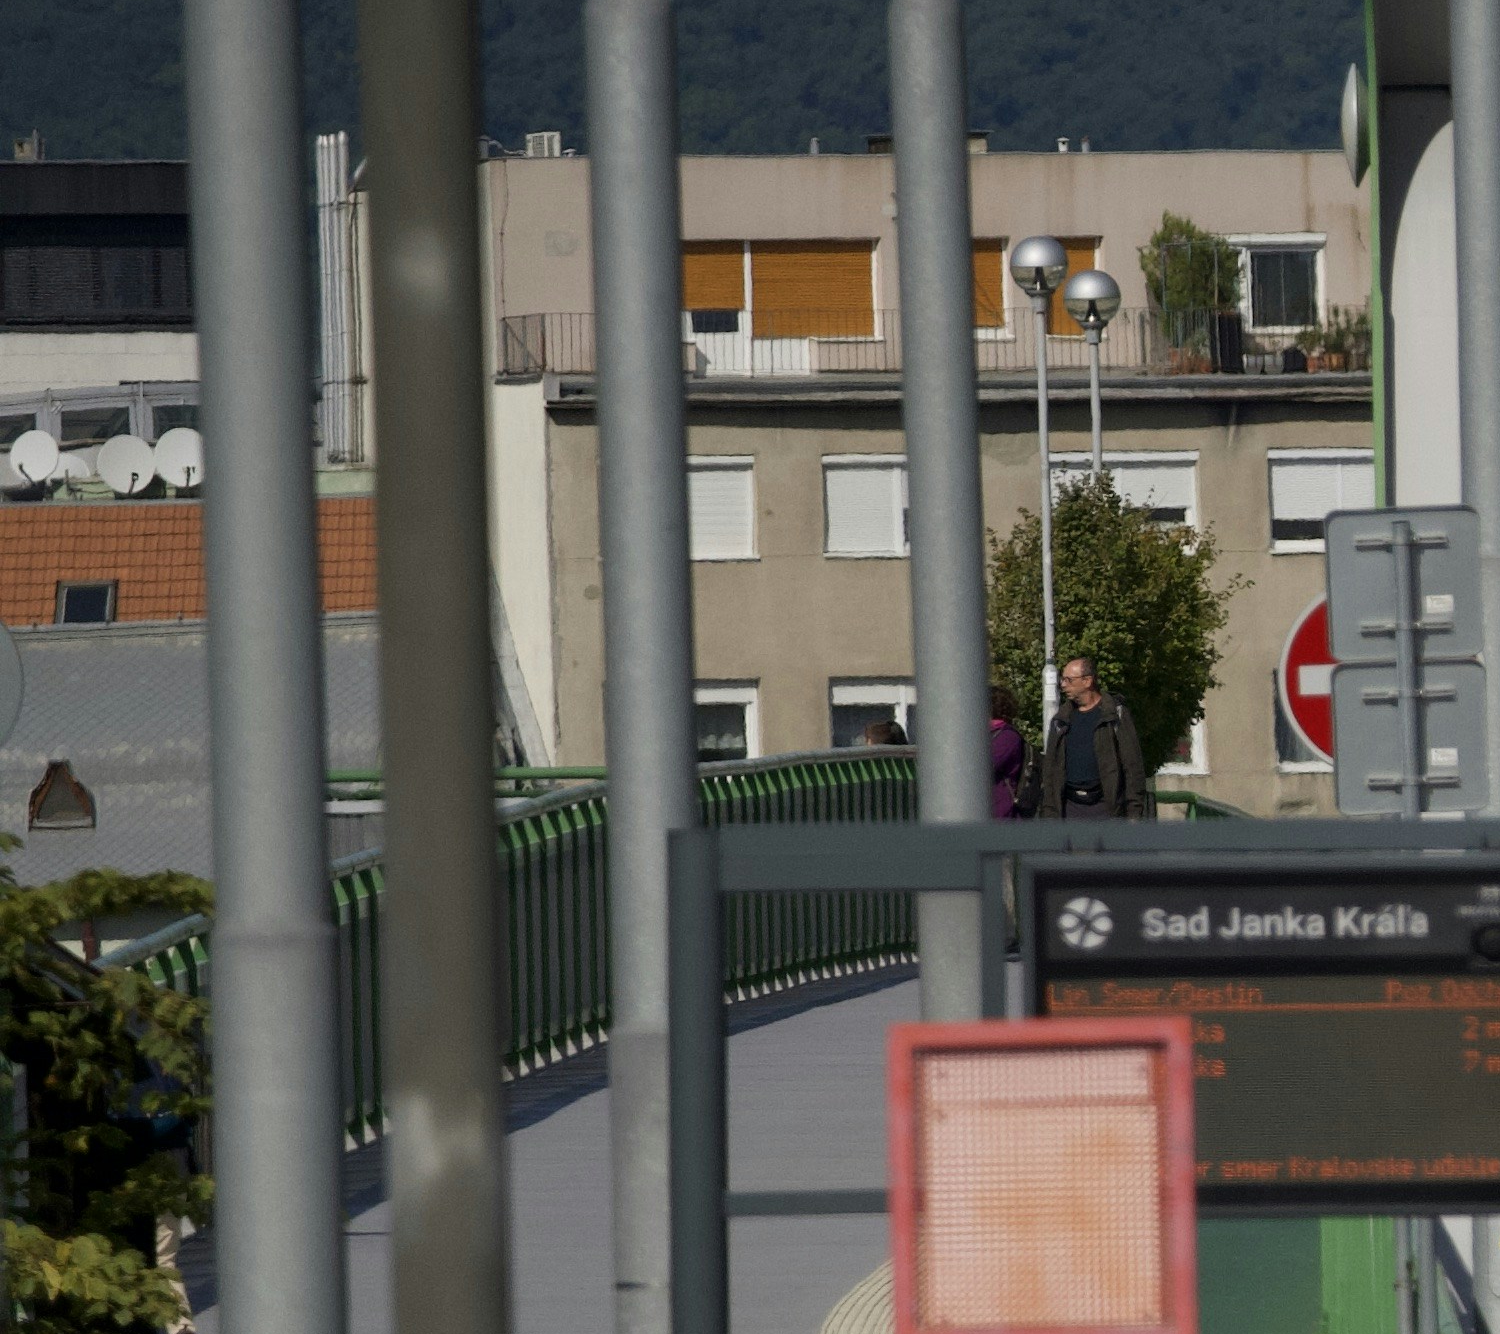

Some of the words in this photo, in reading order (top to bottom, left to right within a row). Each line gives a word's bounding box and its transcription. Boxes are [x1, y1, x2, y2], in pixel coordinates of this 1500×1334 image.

[1142, 905, 1210, 939] Sad
[1218, 906, 1326, 939] Janka
[1333, 903, 1430, 938] Kráľa
[1461, 1016, 1479, 1041] 2
